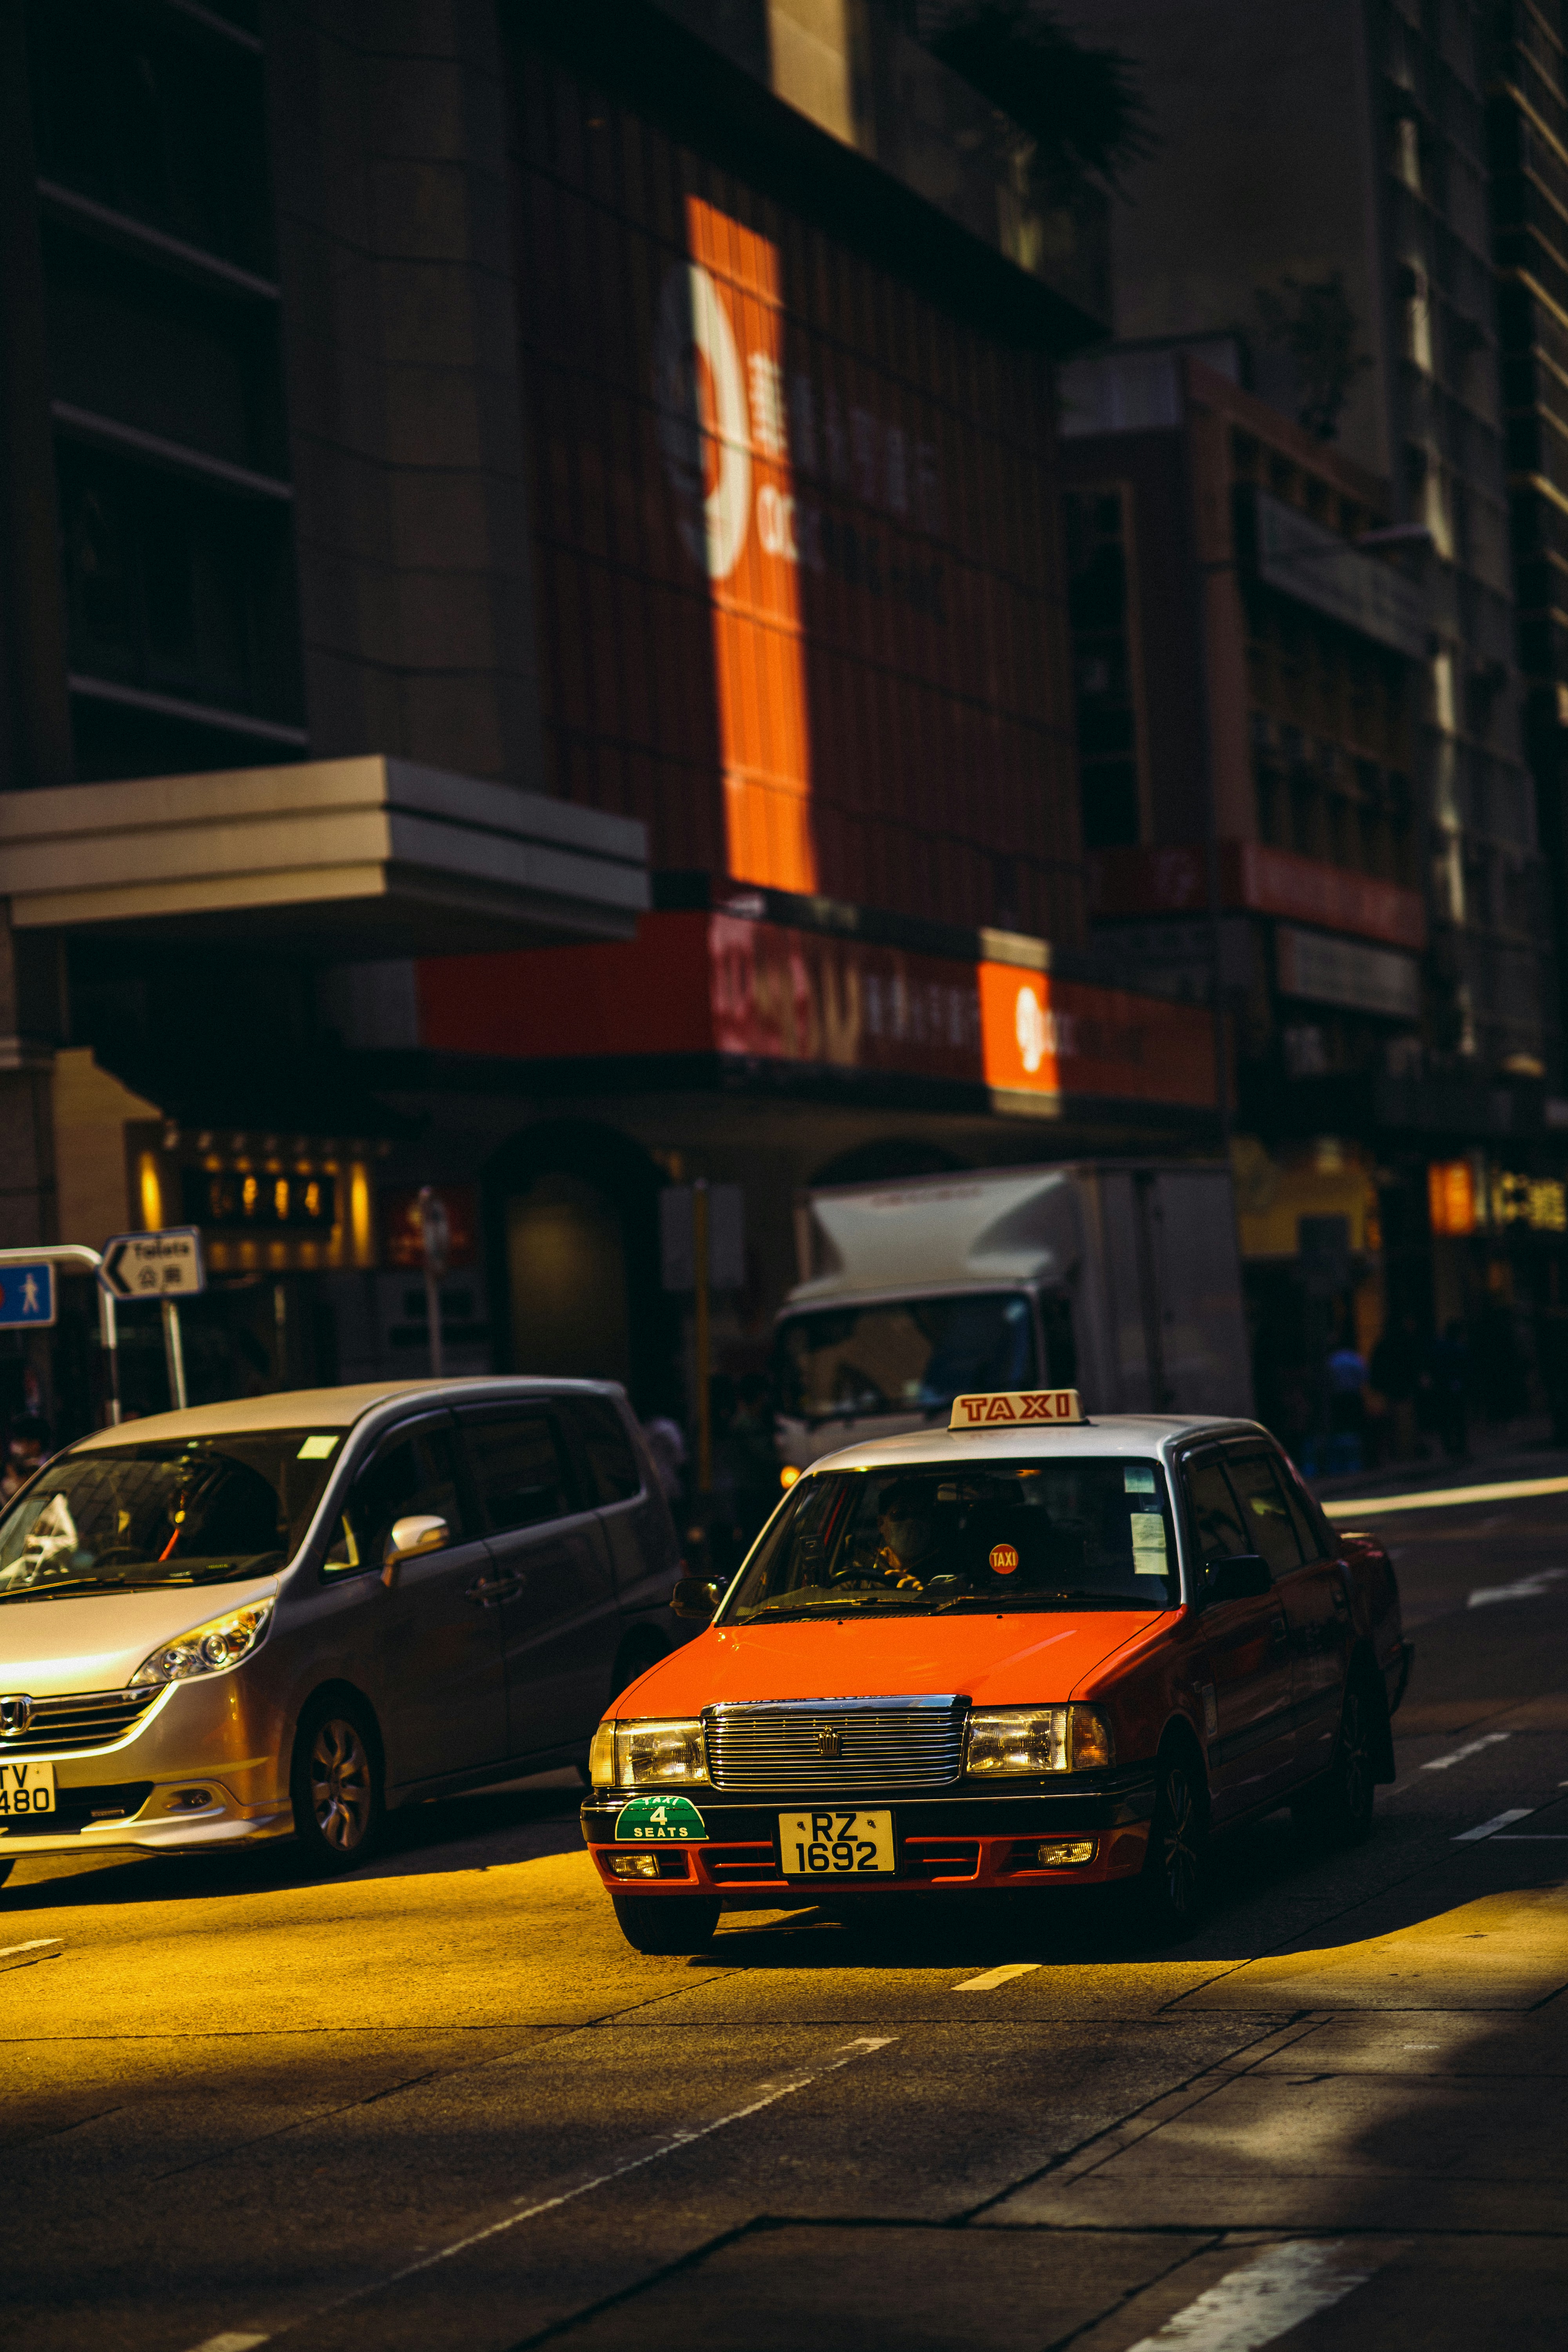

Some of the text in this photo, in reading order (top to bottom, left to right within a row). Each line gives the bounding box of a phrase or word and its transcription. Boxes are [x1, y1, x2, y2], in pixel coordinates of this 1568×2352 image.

[960, 1393, 1070, 1422] TAXI
[991, 1552, 1016, 1567] TAXI
[0, 1765, 27, 1789] TV
[0, 1788, 49, 1813] 480
[642, 1797, 679, 1806] TAXI
[650, 1806, 668, 1826] 4
[811, 1813, 858, 1842] RZ
[634, 1827, 688, 1837] SEATS
[795, 1841, 878, 1872] 1692
